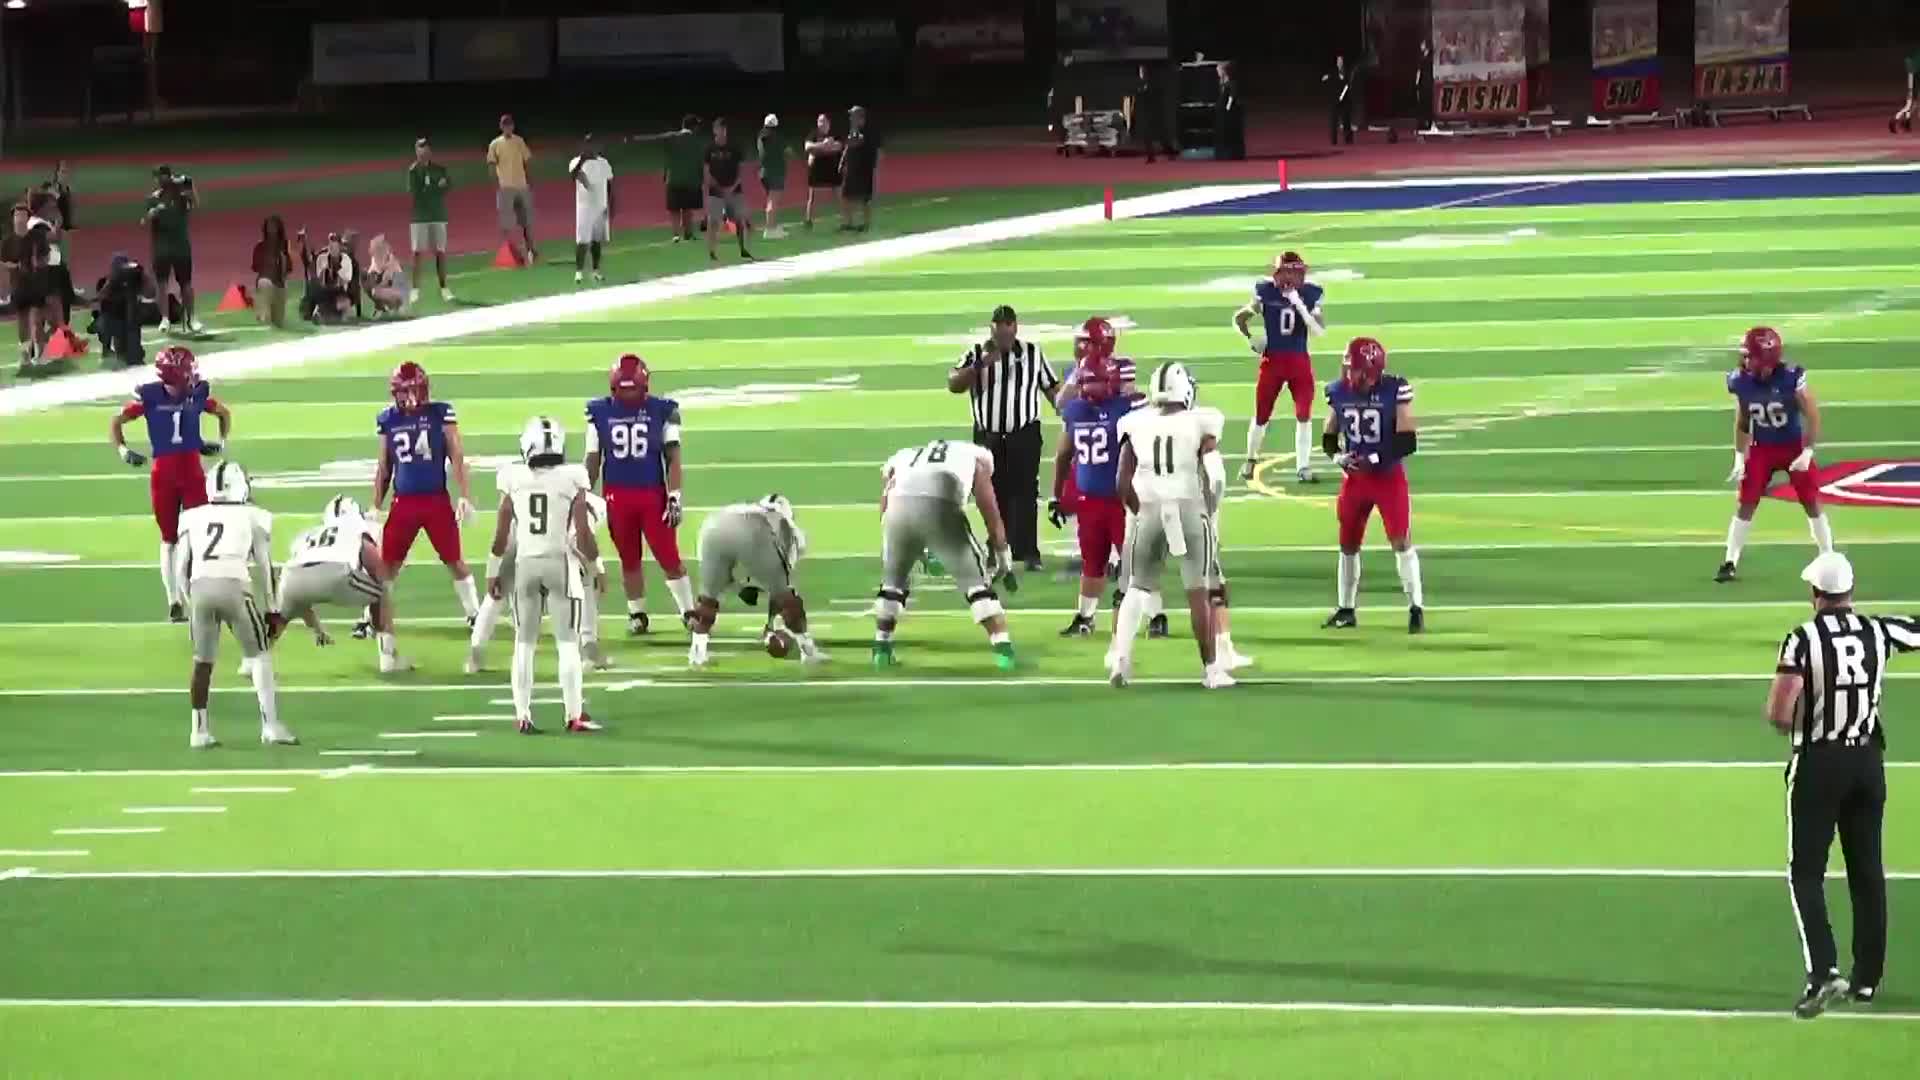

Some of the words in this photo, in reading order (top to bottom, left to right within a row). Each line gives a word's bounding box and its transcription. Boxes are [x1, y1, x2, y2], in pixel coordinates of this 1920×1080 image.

[1280, 307, 1296, 336] 0
[171, 411, 183, 444] 1
[1343, 407, 1381, 444] 33
[1749, 401, 1788, 428] 26
[393, 430, 432, 463] 24
[611, 422, 649, 459] 96
[1073, 426, 1109, 465] 52
[1153, 434, 1174, 475] 11
[529, 492, 548, 535] 9
[202, 522, 224, 560] 2
[1832, 635, 1869, 687] R
